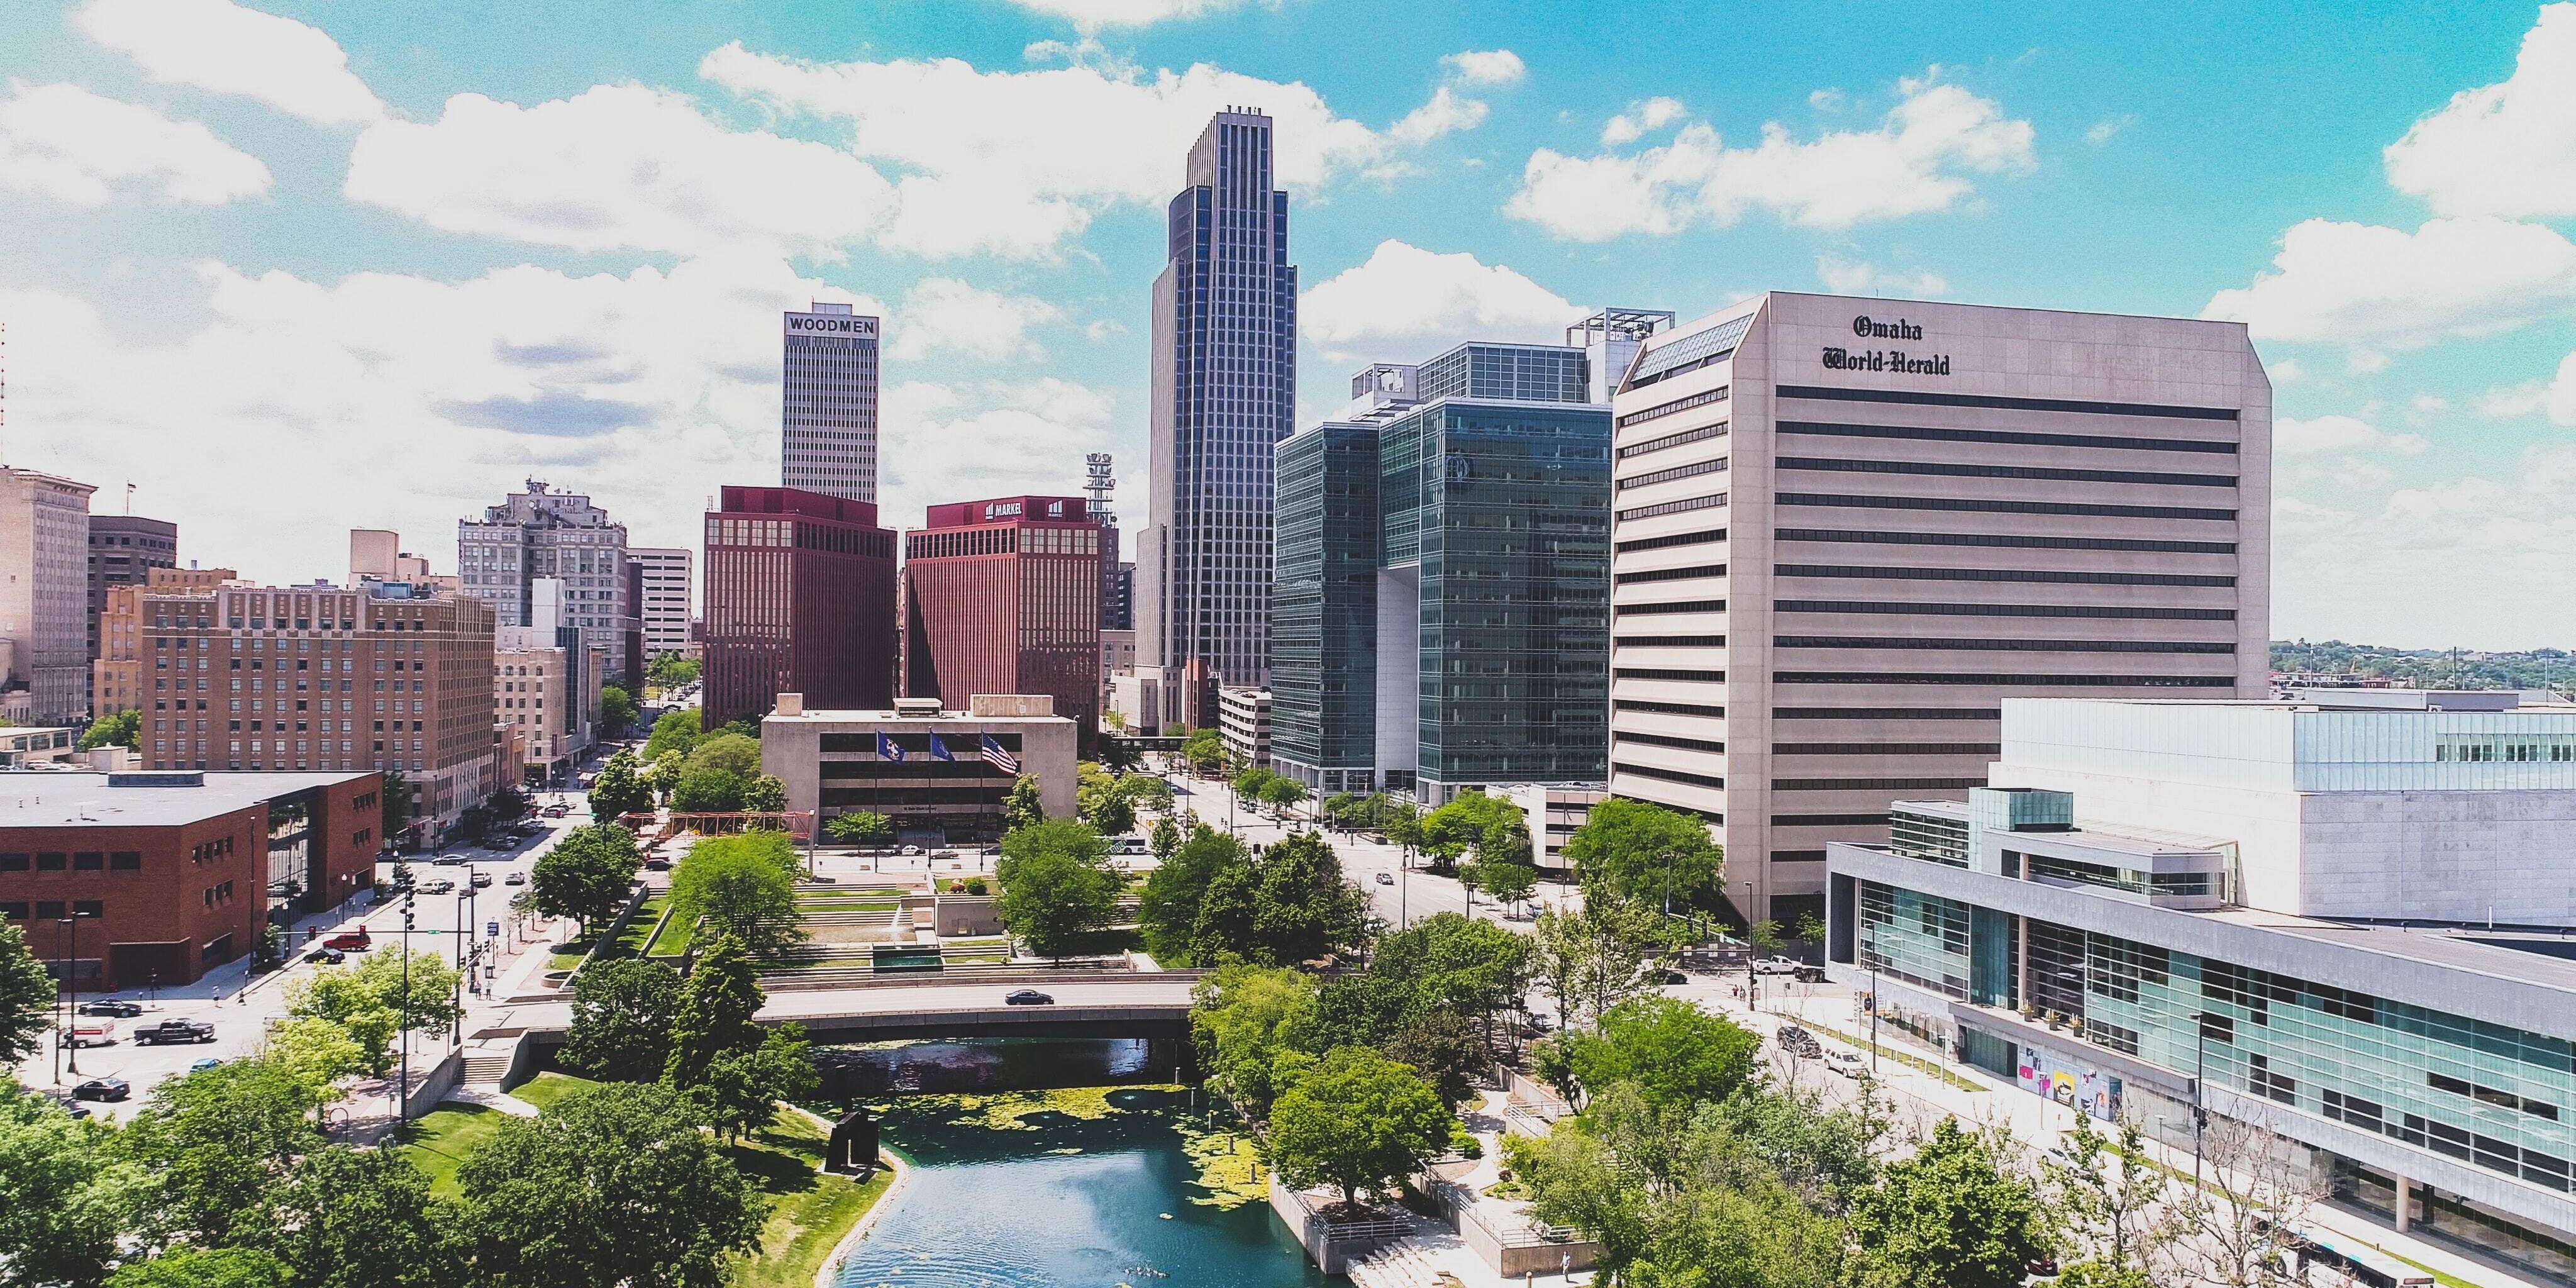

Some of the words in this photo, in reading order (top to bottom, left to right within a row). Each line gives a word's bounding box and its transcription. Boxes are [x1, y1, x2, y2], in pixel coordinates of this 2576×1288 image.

[790, 318, 874, 333] WOODMEN
[1853, 315, 1923, 340] Omaha
[1823, 347, 1950, 375] World-Herald
[996, 502, 1022, 516] MARKEL
